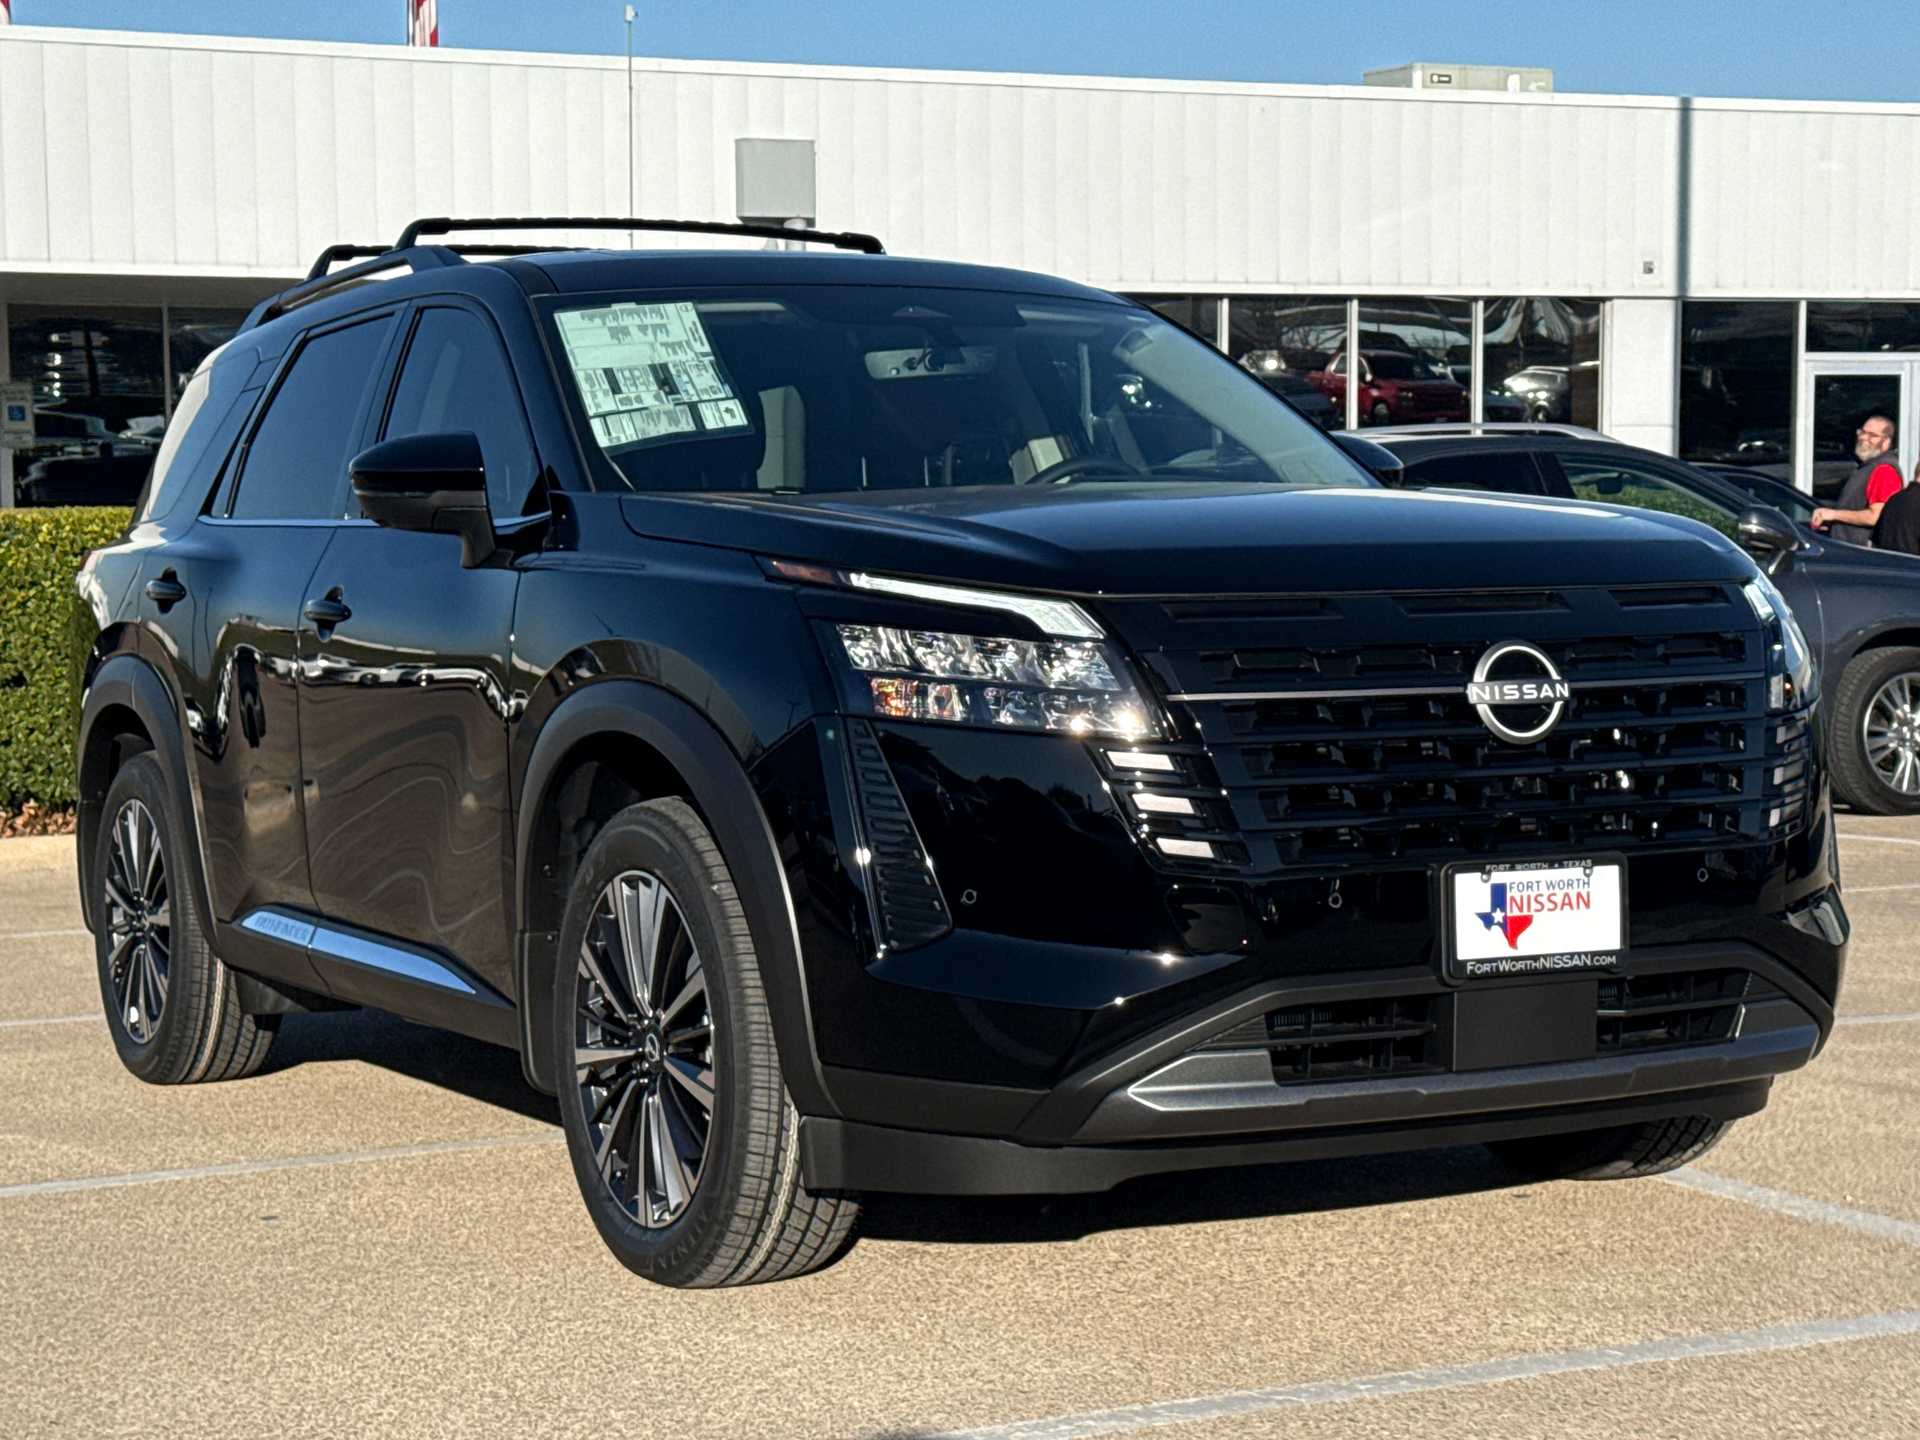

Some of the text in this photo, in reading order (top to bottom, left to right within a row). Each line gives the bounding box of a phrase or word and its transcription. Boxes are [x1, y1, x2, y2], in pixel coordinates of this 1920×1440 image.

[1471, 682, 1569, 701] NISSAN
[1485, 859, 1593, 873] FORT WORTH TEXAS
[1509, 877, 1591, 893] FORT WORTH
[1509, 891, 1591, 914] NISSAN
[255, 916, 308, 941] PATHFINDER
